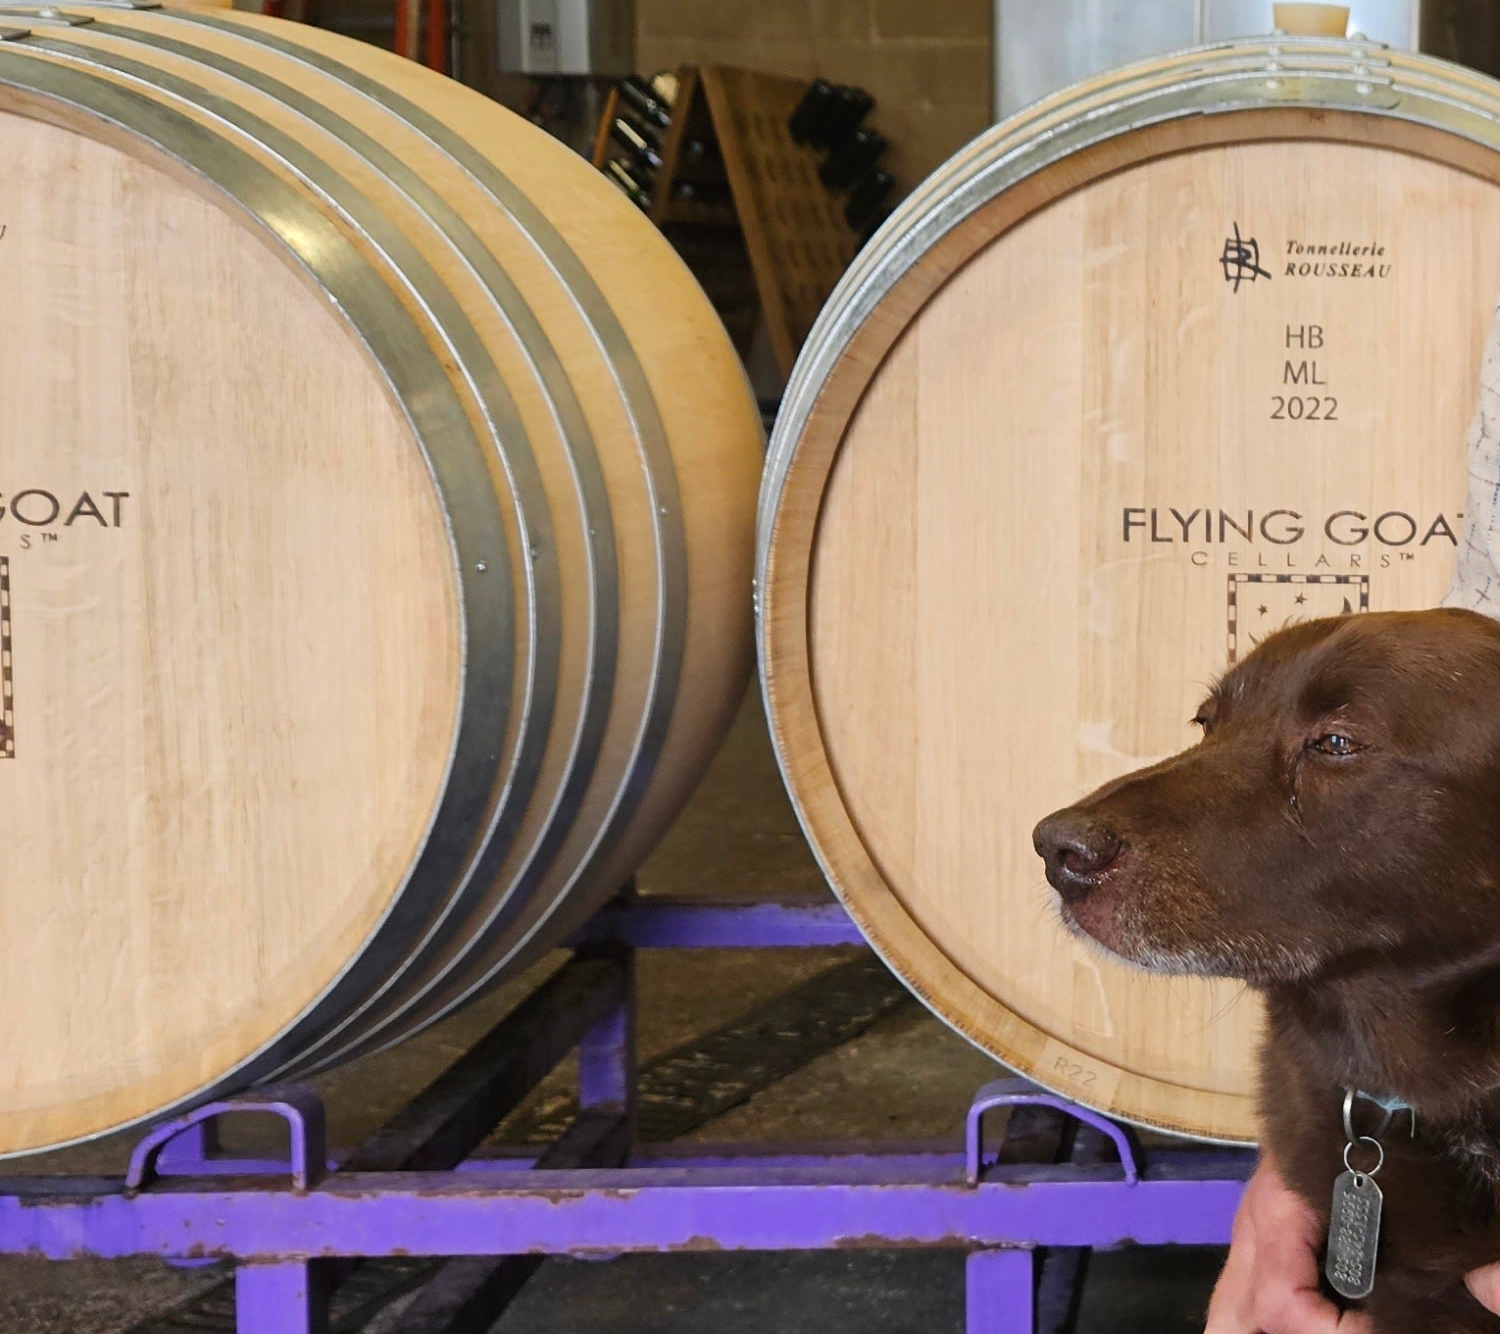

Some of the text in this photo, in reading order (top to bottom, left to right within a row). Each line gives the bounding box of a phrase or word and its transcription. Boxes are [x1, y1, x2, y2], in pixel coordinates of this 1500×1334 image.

[1285, 240, 1386, 257] Tonnellerie
[1283, 261, 1392, 279] ROUSSEAU
[1285, 323, 1325, 350] HB
[1282, 359, 1327, 386] ML
[1269, 395, 1339, 421] 2022
[1122, 506, 1464, 548] FLYING GOA
